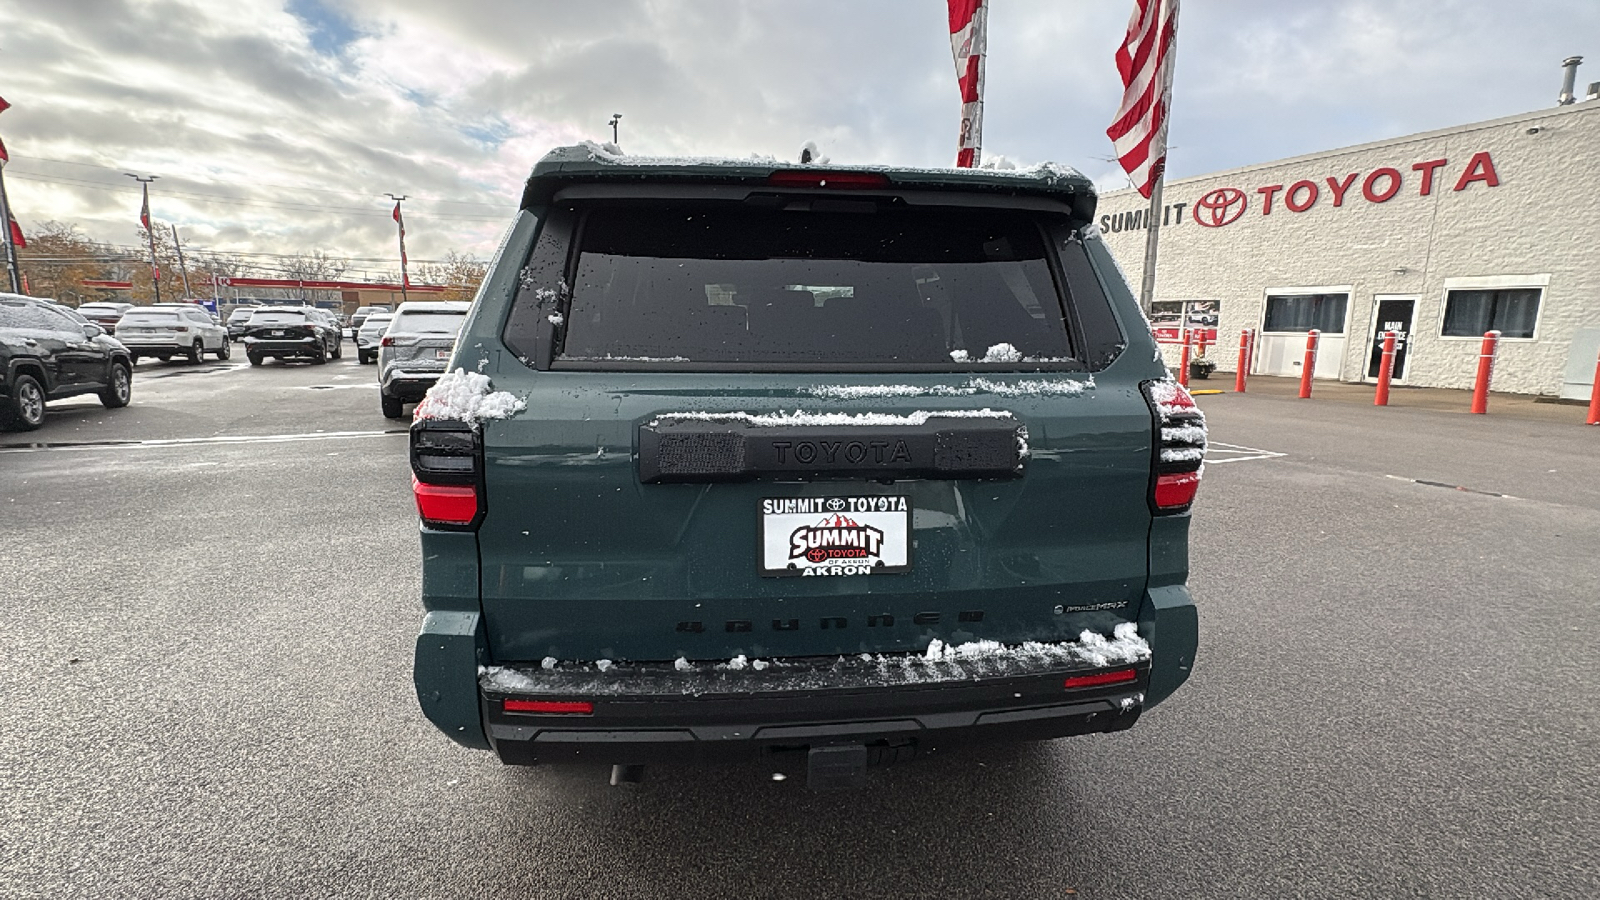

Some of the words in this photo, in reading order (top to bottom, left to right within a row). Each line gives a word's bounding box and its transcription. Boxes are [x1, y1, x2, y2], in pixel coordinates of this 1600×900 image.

[1257, 151, 1499, 215] TOYOTA
[1384, 321, 1403, 330] MAIN
[771, 438, 913, 464] TOYOTA
[763, 498, 824, 514] SUMMIT
[848, 496, 907, 512] TOYOTA
[790, 526, 882, 558] SUMMIT
[828, 549, 867, 557] TOYOTA
[802, 566, 871, 576] AKRON
